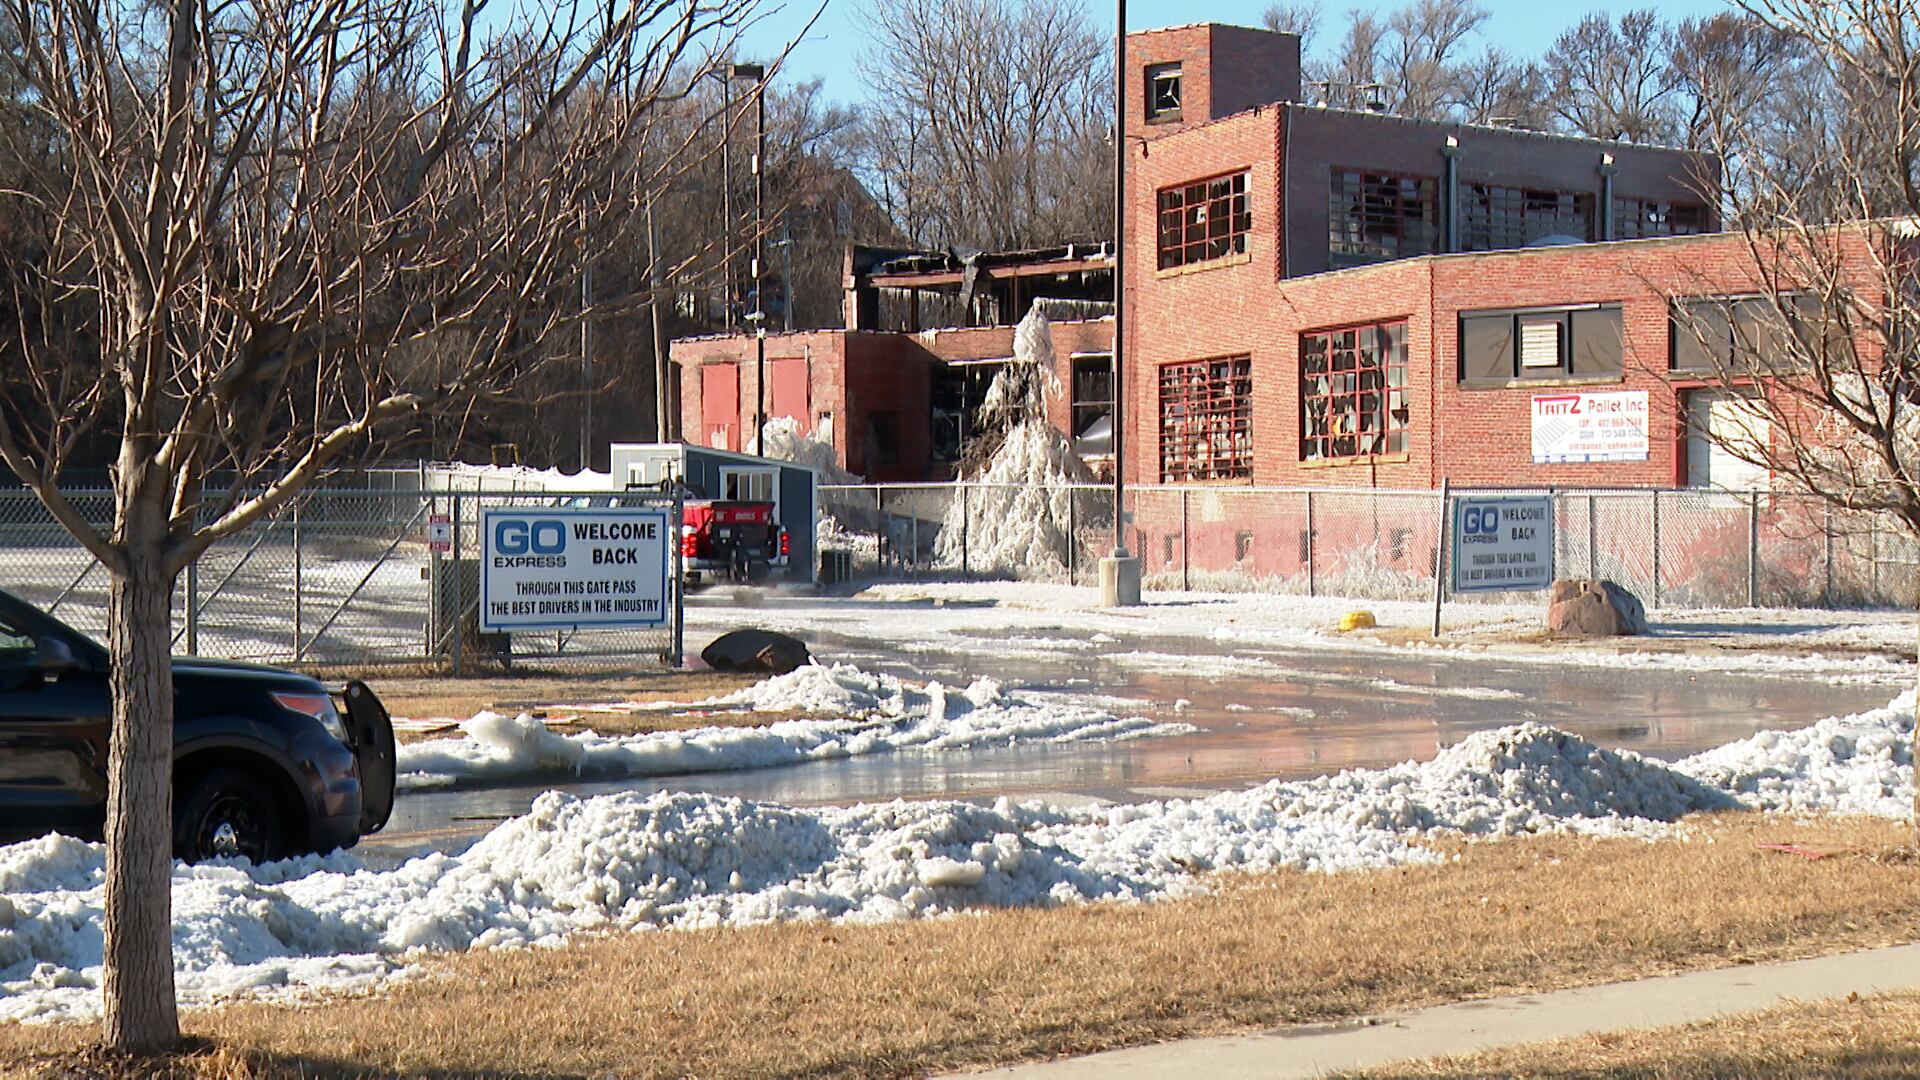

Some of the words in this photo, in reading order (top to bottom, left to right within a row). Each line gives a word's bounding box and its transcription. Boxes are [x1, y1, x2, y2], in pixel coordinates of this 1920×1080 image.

[1589, 399, 1621, 413] Pallet
[1464, 507, 1499, 534] GO
[1502, 507, 1545, 521] WELCOME
[495, 519, 566, 555] GO
[574, 523, 656, 540] WELCOME
[1511, 527, 1536, 540] BACK
[494, 556, 567, 568] EXPRESS
[592, 548, 638, 564] BACK
[516, 582, 561, 596] THROUGH
[564, 581, 584, 594] THIS
[587, 581, 610, 594] GATE
[612, 580, 636, 594] PASS
[491, 602, 508, 616] THE
[512, 602, 535, 615] BEST
[539, 600, 579, 614] DRIVERS
[582, 600, 591, 613] IN
[594, 600, 611, 612] THE
[614, 599, 658, 613] INDUSTRY
